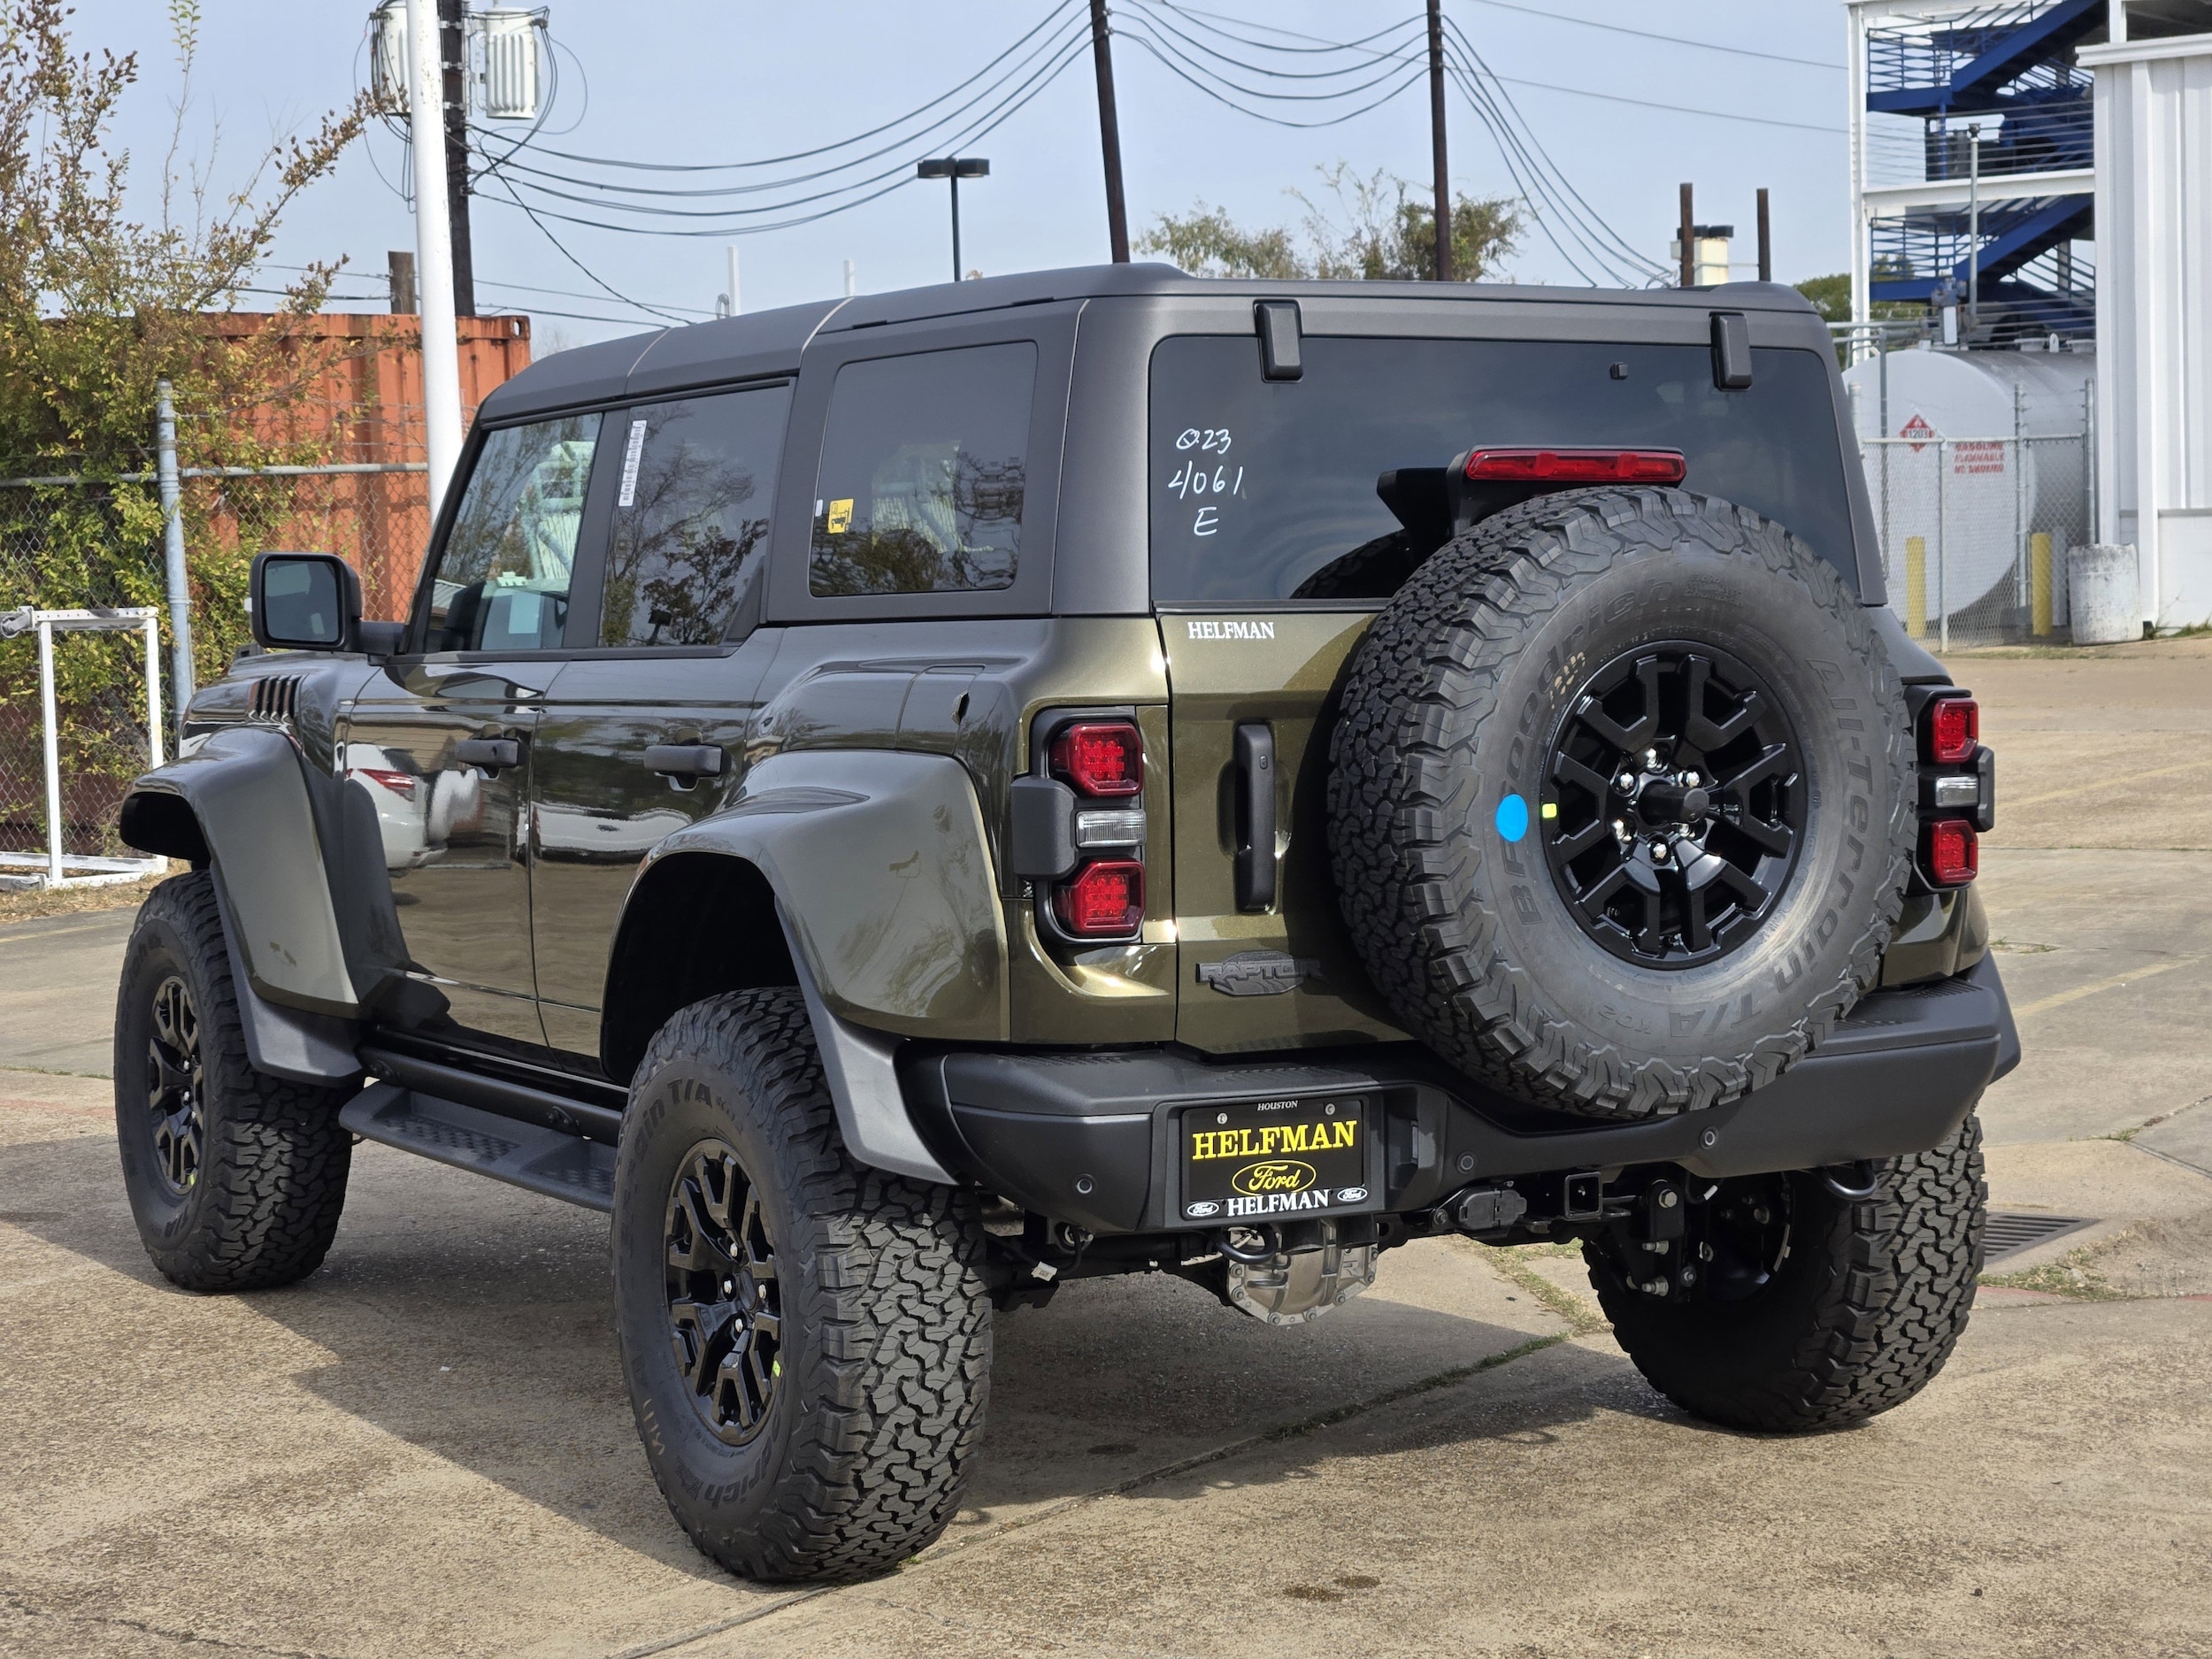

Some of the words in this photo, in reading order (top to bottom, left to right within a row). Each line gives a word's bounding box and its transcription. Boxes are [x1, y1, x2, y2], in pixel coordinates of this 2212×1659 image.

[1168, 460, 1243, 499] 4061
[1194, 506, 1219, 535] E
[1187, 621, 1275, 639] HELFMAN
[1196, 958, 1325, 988] RAPTOR
[667, 1078, 713, 1108] T/A
[1257, 1100, 1298, 1111] HOUSTON
[1192, 1120, 1357, 1160] HELFMAN
[1248, 1164, 1302, 1191] Ford
[1227, 1189, 1329, 1217] HELFMAN
